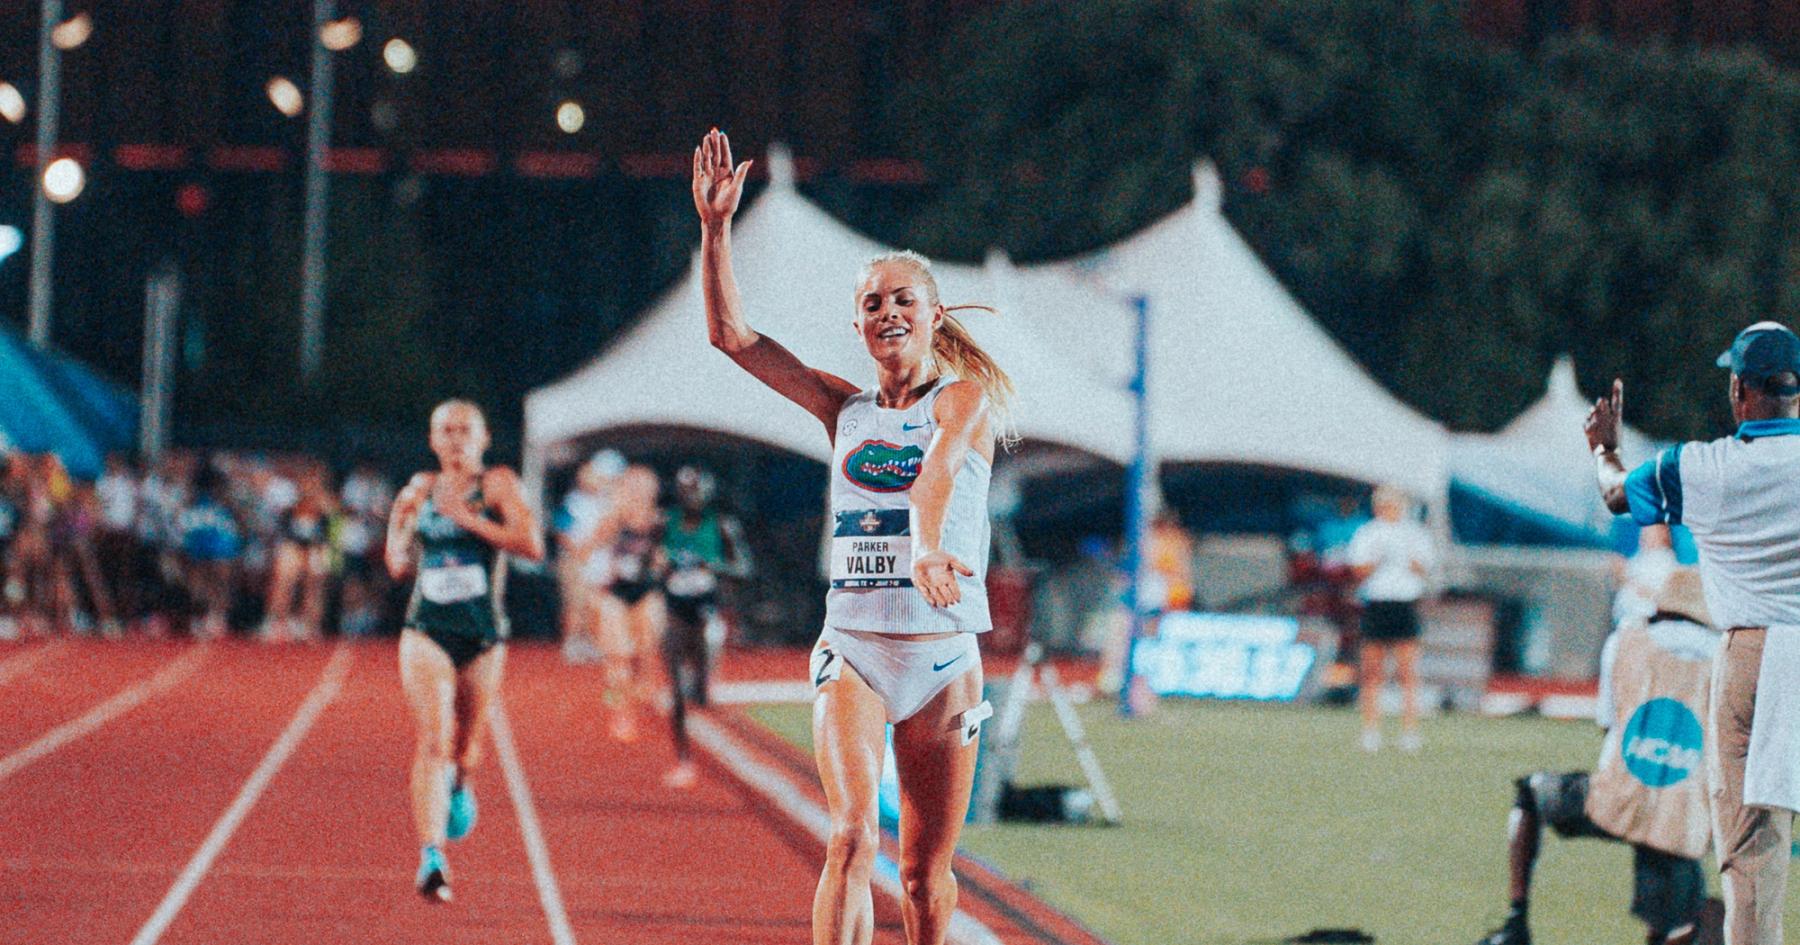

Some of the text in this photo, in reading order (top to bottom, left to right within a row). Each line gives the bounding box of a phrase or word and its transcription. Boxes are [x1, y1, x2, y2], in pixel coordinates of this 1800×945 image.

[852, 541, 889, 553] PARKER
[846, 555, 897, 575] VALBY
[815, 648, 835, 688] 2
